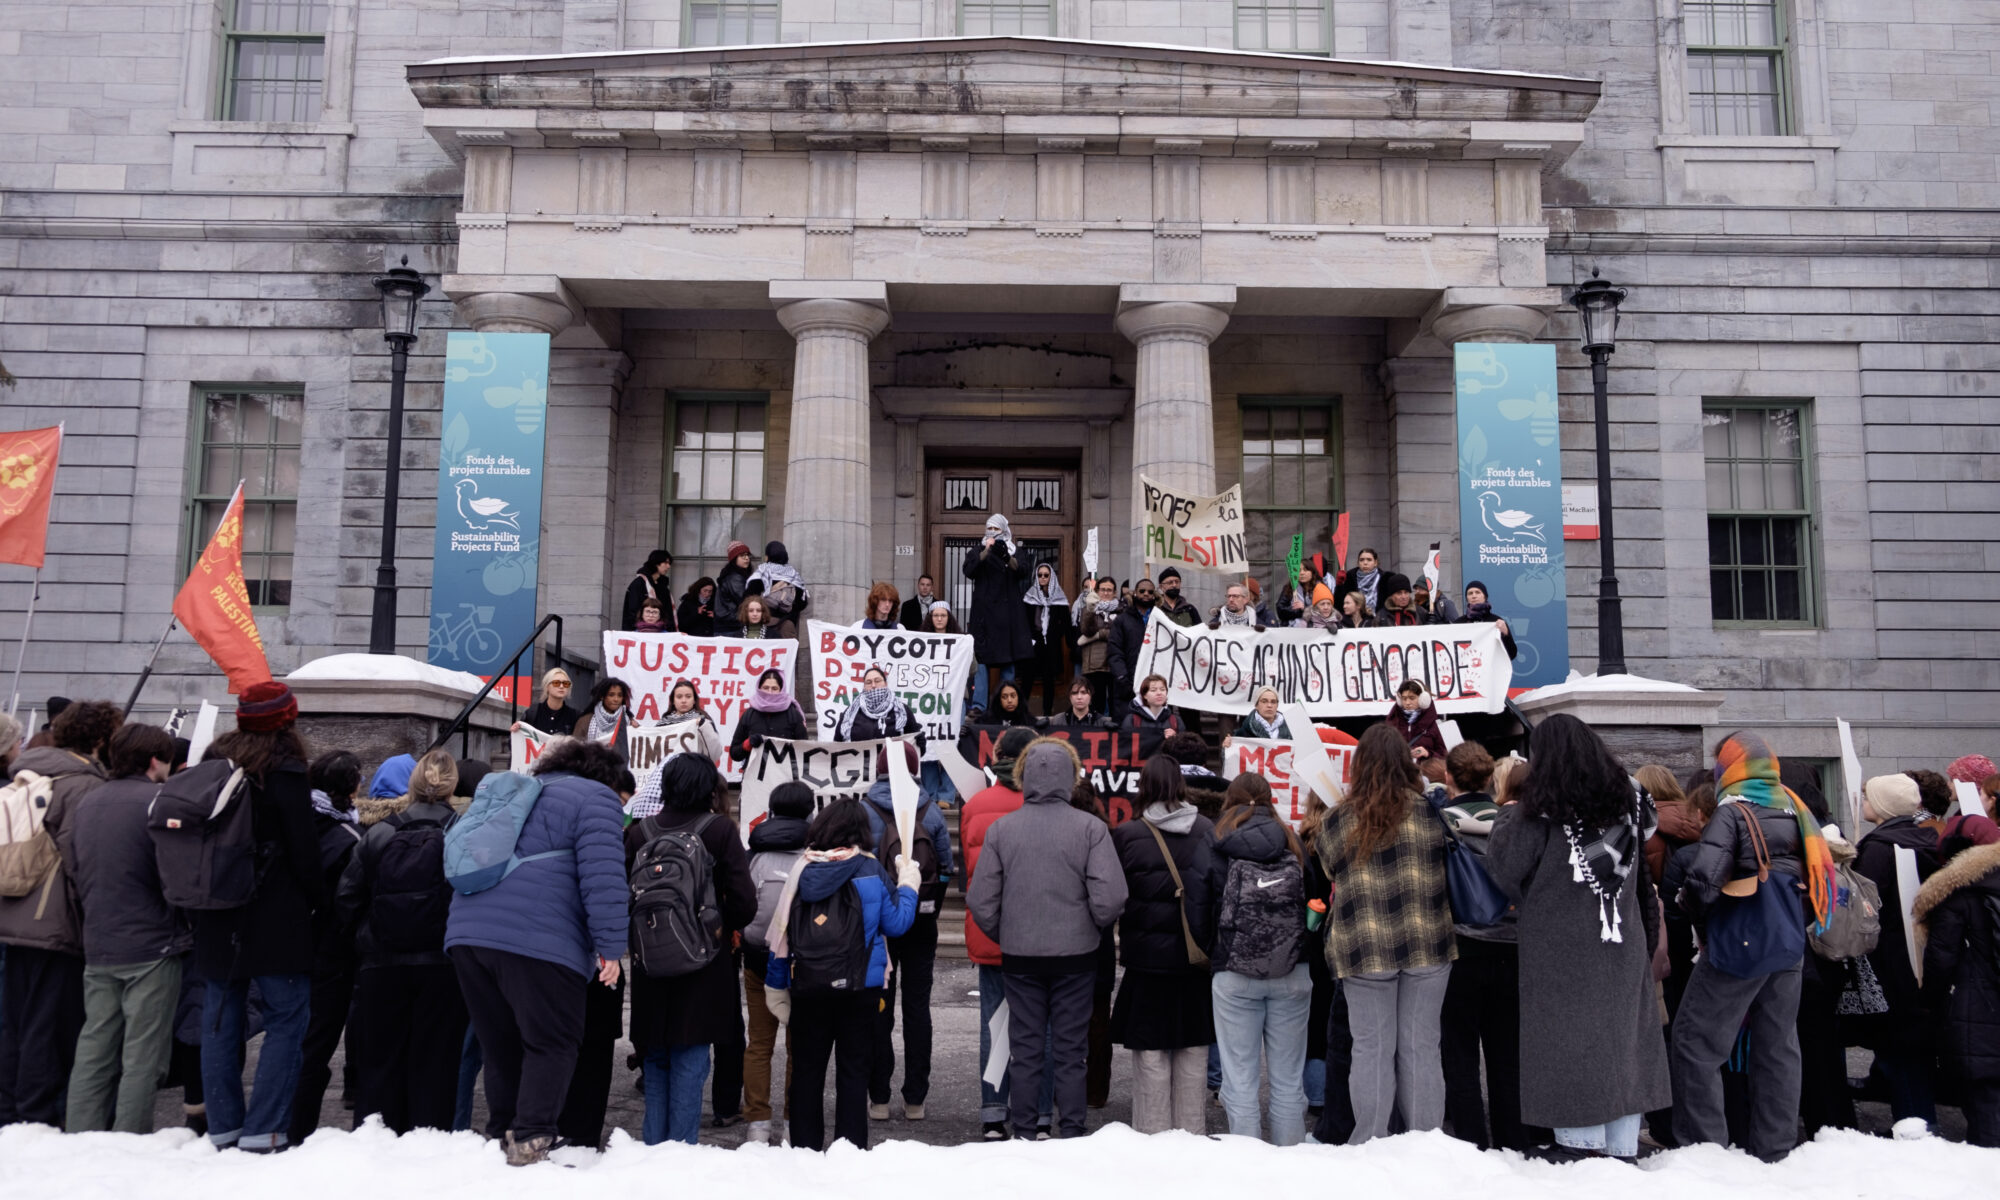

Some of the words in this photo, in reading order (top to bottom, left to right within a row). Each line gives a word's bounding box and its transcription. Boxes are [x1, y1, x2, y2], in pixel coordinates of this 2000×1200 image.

[466, 455, 495, 465] Fonds
[498, 455, 515, 465] des
[449, 465, 484, 477] projets
[486, 465, 531, 475] durables
[1486, 467, 1515, 477] Fonds
[1518, 467, 1535, 477] des
[1471, 477, 1506, 489] projets
[1508, 477, 1551, 487] durables
[451, 532, 520, 544] Sustainability
[451, 542, 491, 554] Projects
[494, 542, 520, 552] Fund
[1479, 544, 1547, 556] Sustainability
[1480, 554, 1520, 565] Projects
[1522, 554, 1548, 564] Fund
[820, 631, 957, 659] BOYCOTT
[1150, 621, 1244, 696] PROFS
[1248, 643, 1336, 703] AGAINST
[1342, 640, 1477, 701] GENOCIDE
[710, 680, 746, 697] THE
